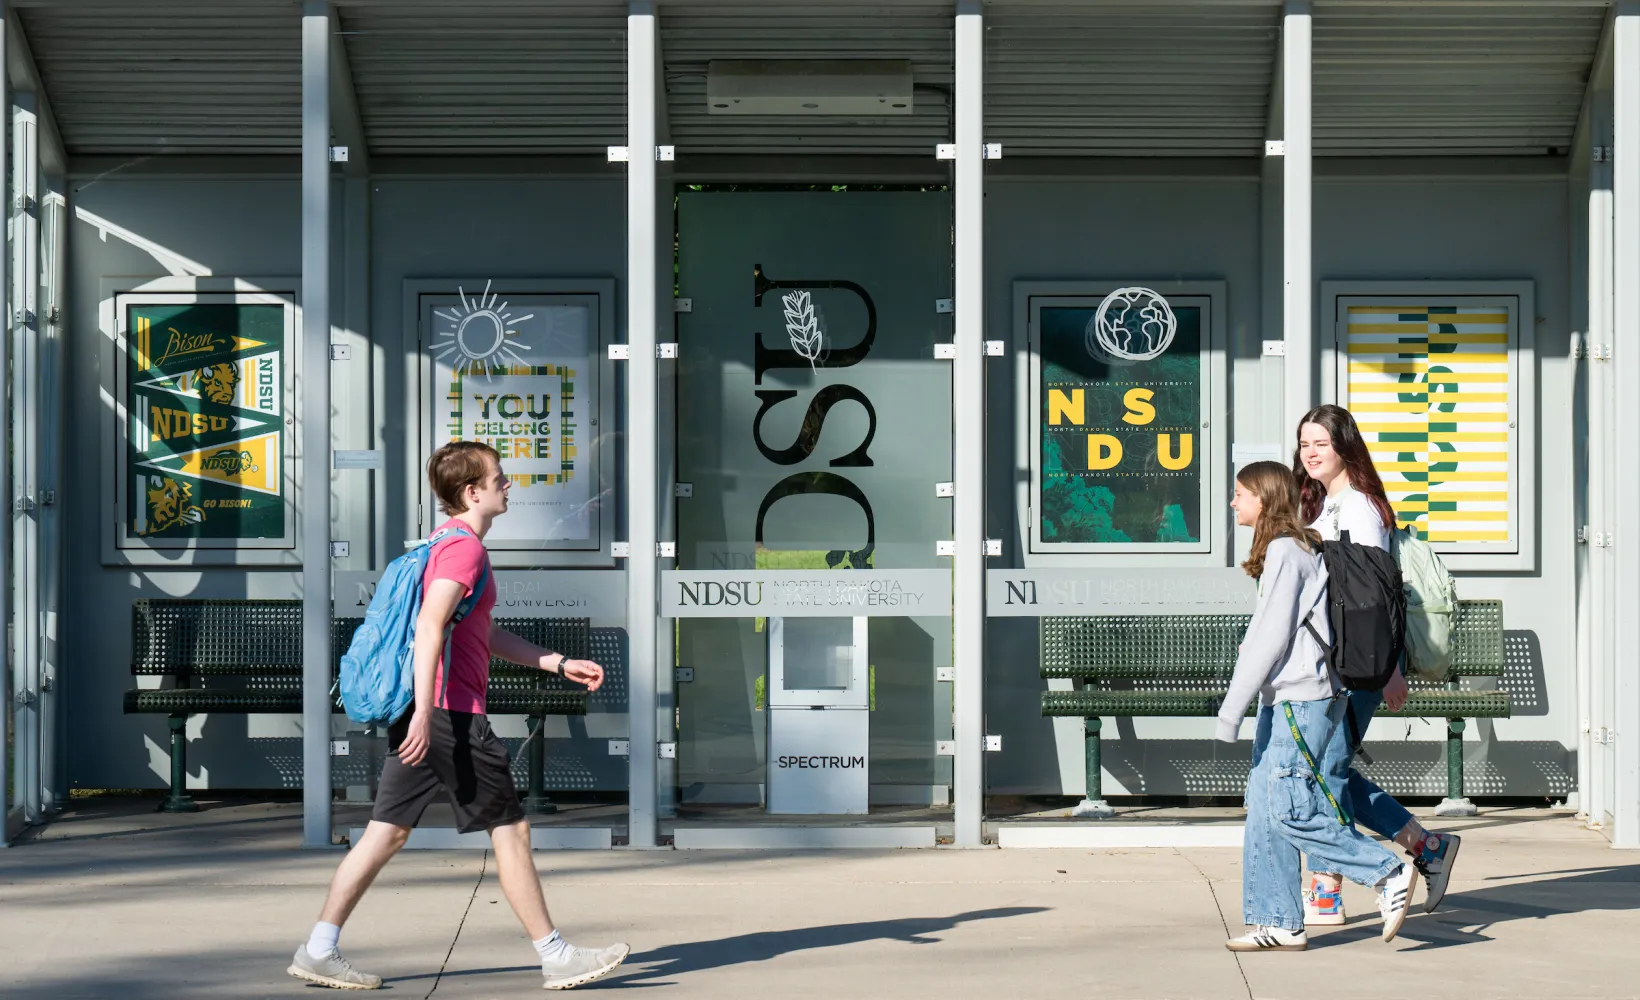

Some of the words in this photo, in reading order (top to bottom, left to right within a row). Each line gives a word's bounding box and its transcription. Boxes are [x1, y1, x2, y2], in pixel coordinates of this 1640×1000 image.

[154, 327, 225, 367] Bison
[259, 357, 273, 411] NDSU
[472, 394, 551, 420] YOU
[753, 263, 876, 569] DSU
[151, 405, 228, 442] NDSU
[475, 421, 551, 435] BELONG
[200, 458, 240, 470] NDSU
[203, 499, 216, 508] GO
[218, 499, 252, 508] BISON!
[678, 581, 765, 606] NDSU
[773, 580, 831, 593] NORTH
[836, 580, 903, 593] DAKOTA
[828, 592, 926, 606] UNIVERSITY
[778, 756, 865, 769] SPECTRUM
